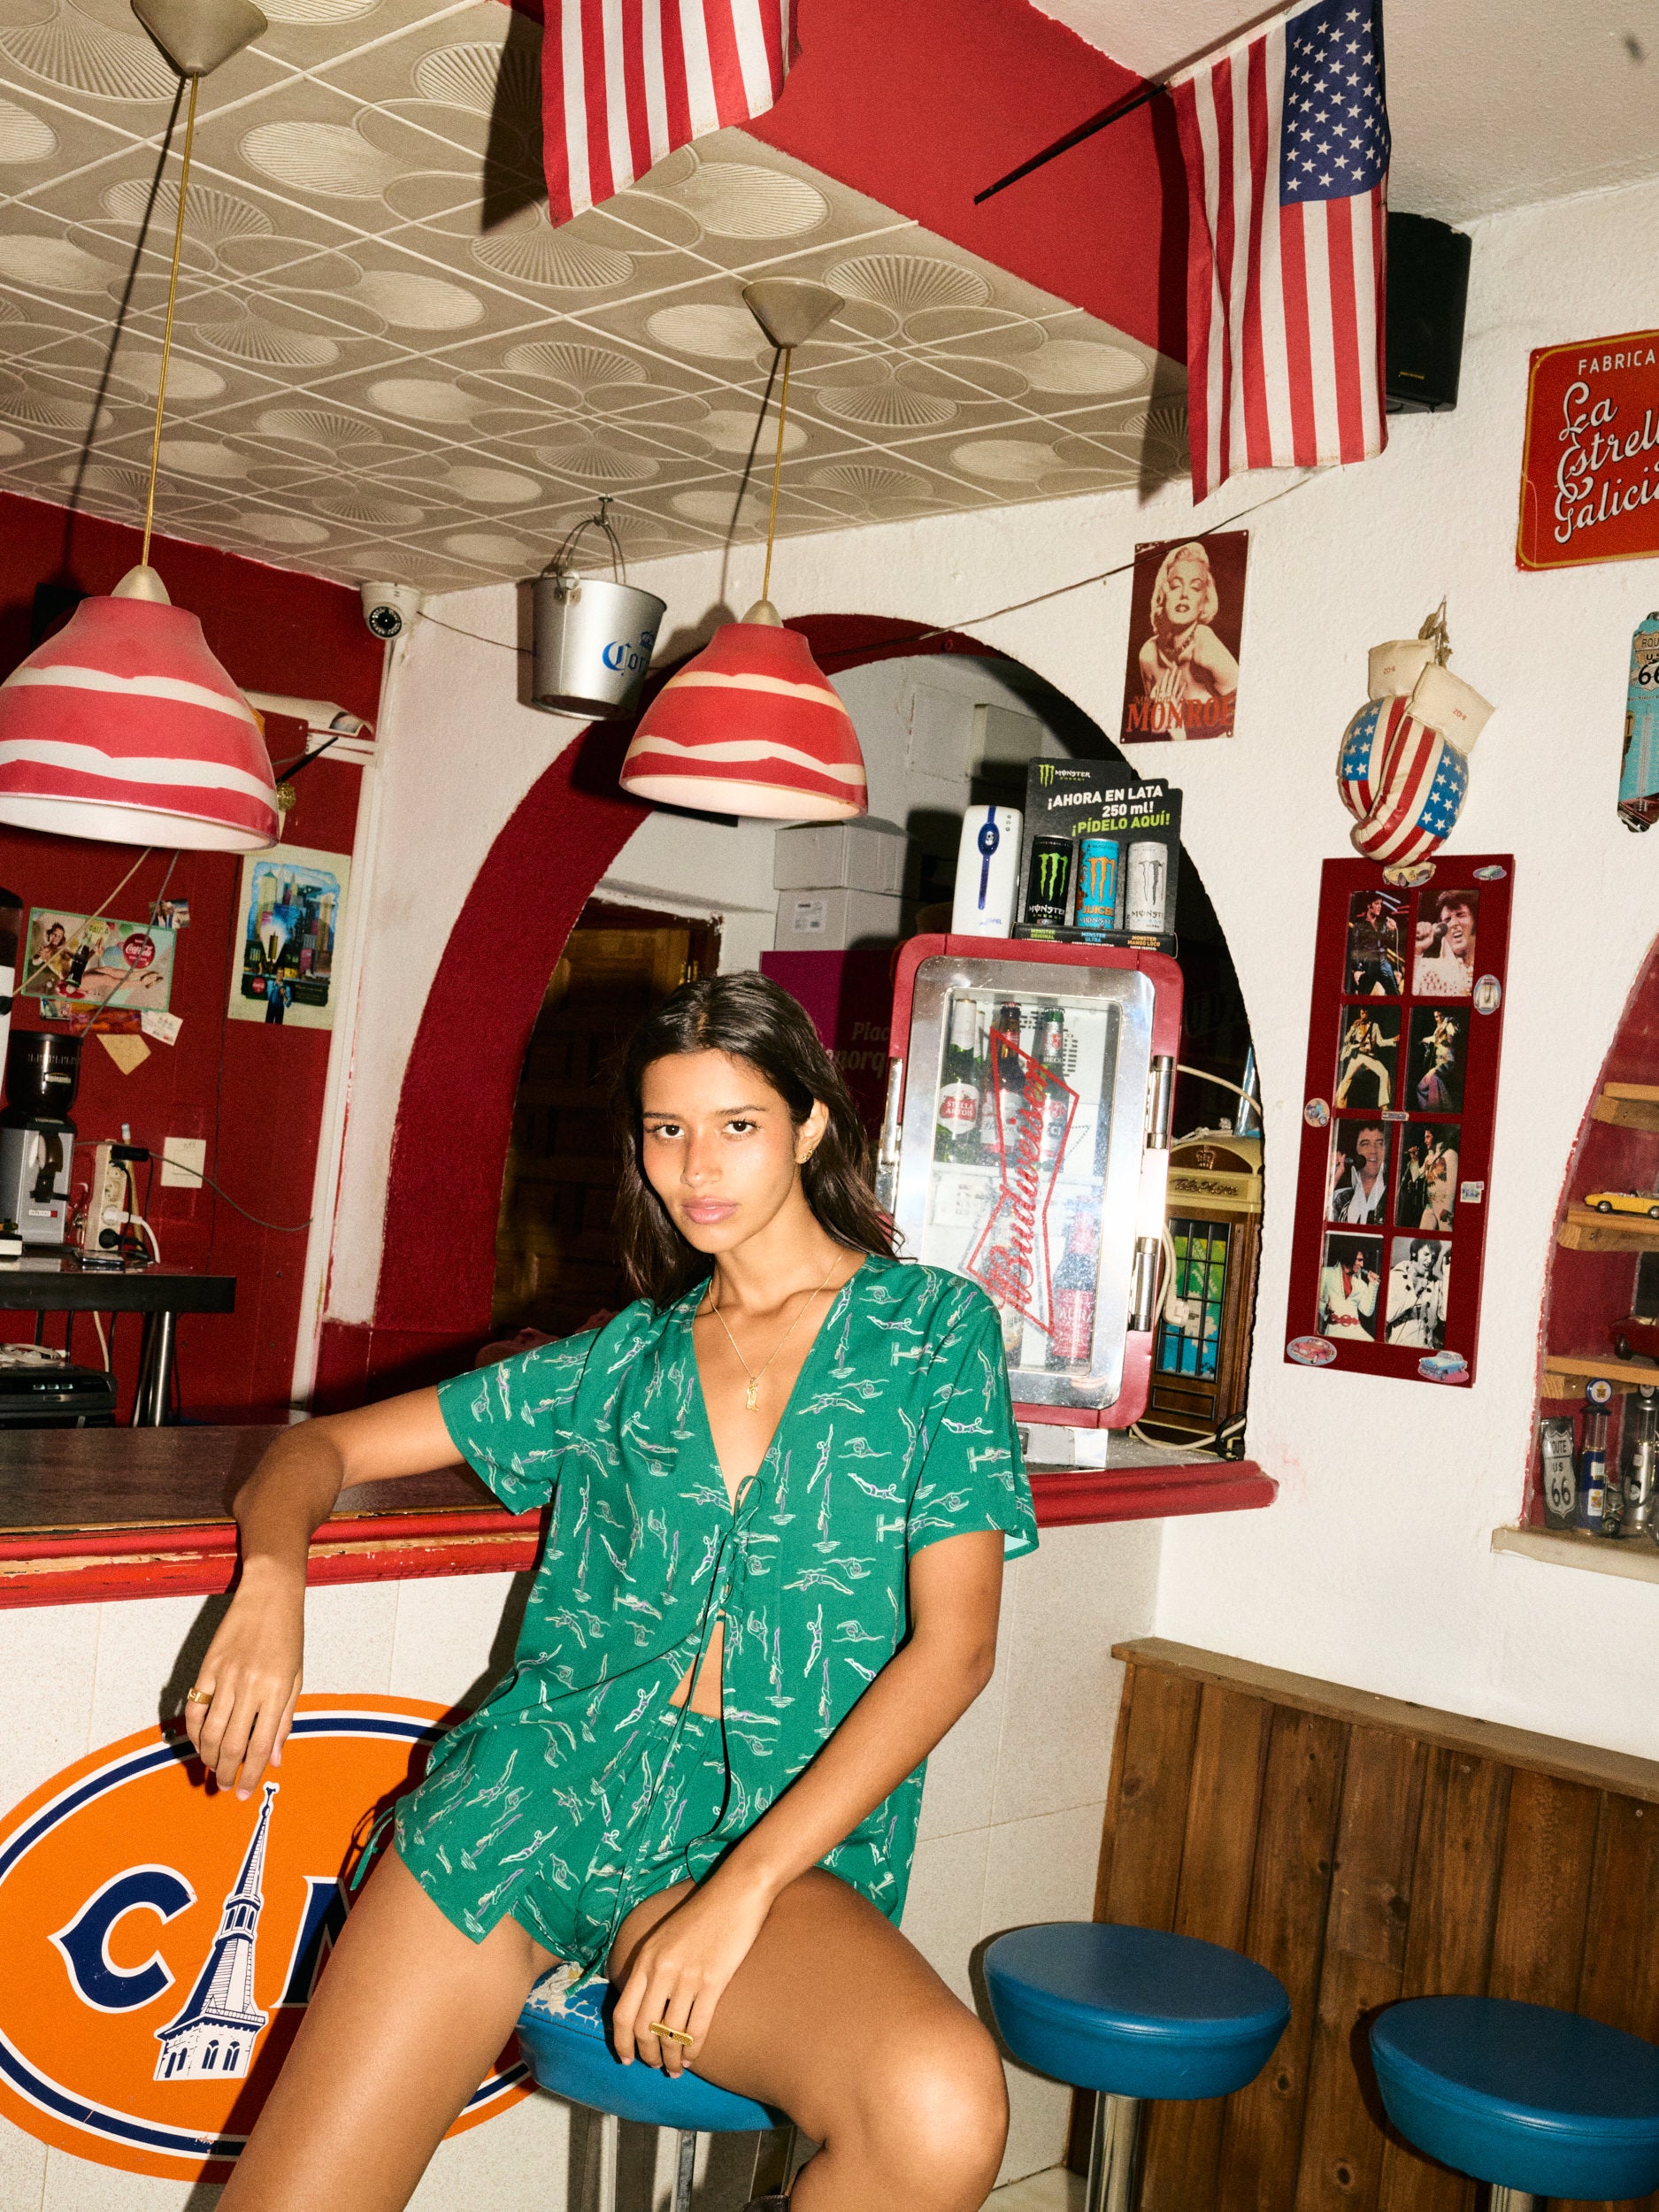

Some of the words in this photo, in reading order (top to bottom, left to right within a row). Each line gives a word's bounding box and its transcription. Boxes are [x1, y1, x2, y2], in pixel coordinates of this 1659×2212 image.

[1578, 349, 1655, 376] FABRICA
[1558, 381, 1618, 442] La
[1125, 696, 1236, 733] MONROE
[1055, 769, 1091, 779] MONSTER
[1048, 790, 1102, 810] ¡AHORA
[1105, 788, 1126, 803] EN
[1127, 785, 1164, 800] LATA
[1102, 803, 1127, 818] 250
[1071, 817, 1128, 837] ¡PÍDELO
[1130, 810, 1171, 829] AQUÍ!
[1028, 903, 1065, 916] MONSTE
[947, 1101, 973, 1110] STELLA
[1551, 1476, 1571, 1508] 66
